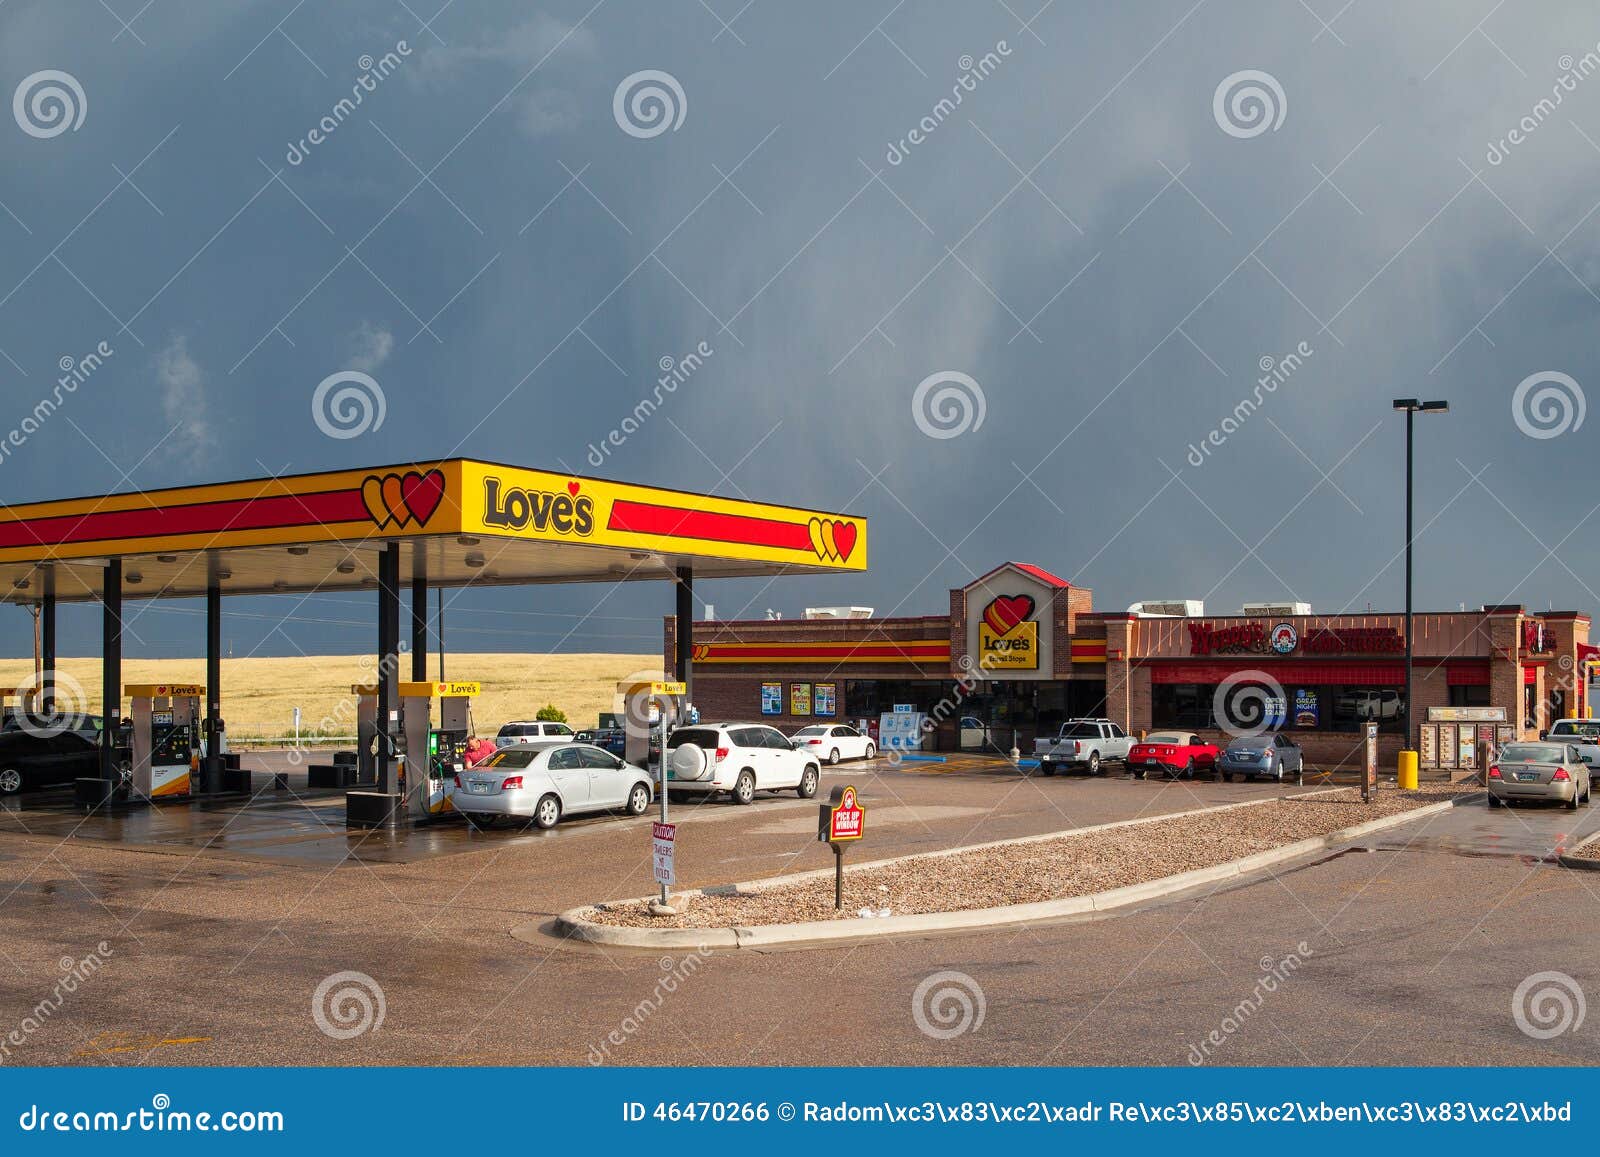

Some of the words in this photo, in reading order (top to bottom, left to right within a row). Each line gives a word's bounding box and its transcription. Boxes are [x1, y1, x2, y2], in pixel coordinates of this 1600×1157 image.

[836, 811, 850, 821] PICK
[851, 811, 860, 821] UP
[836, 820, 859, 830] WINDOW
